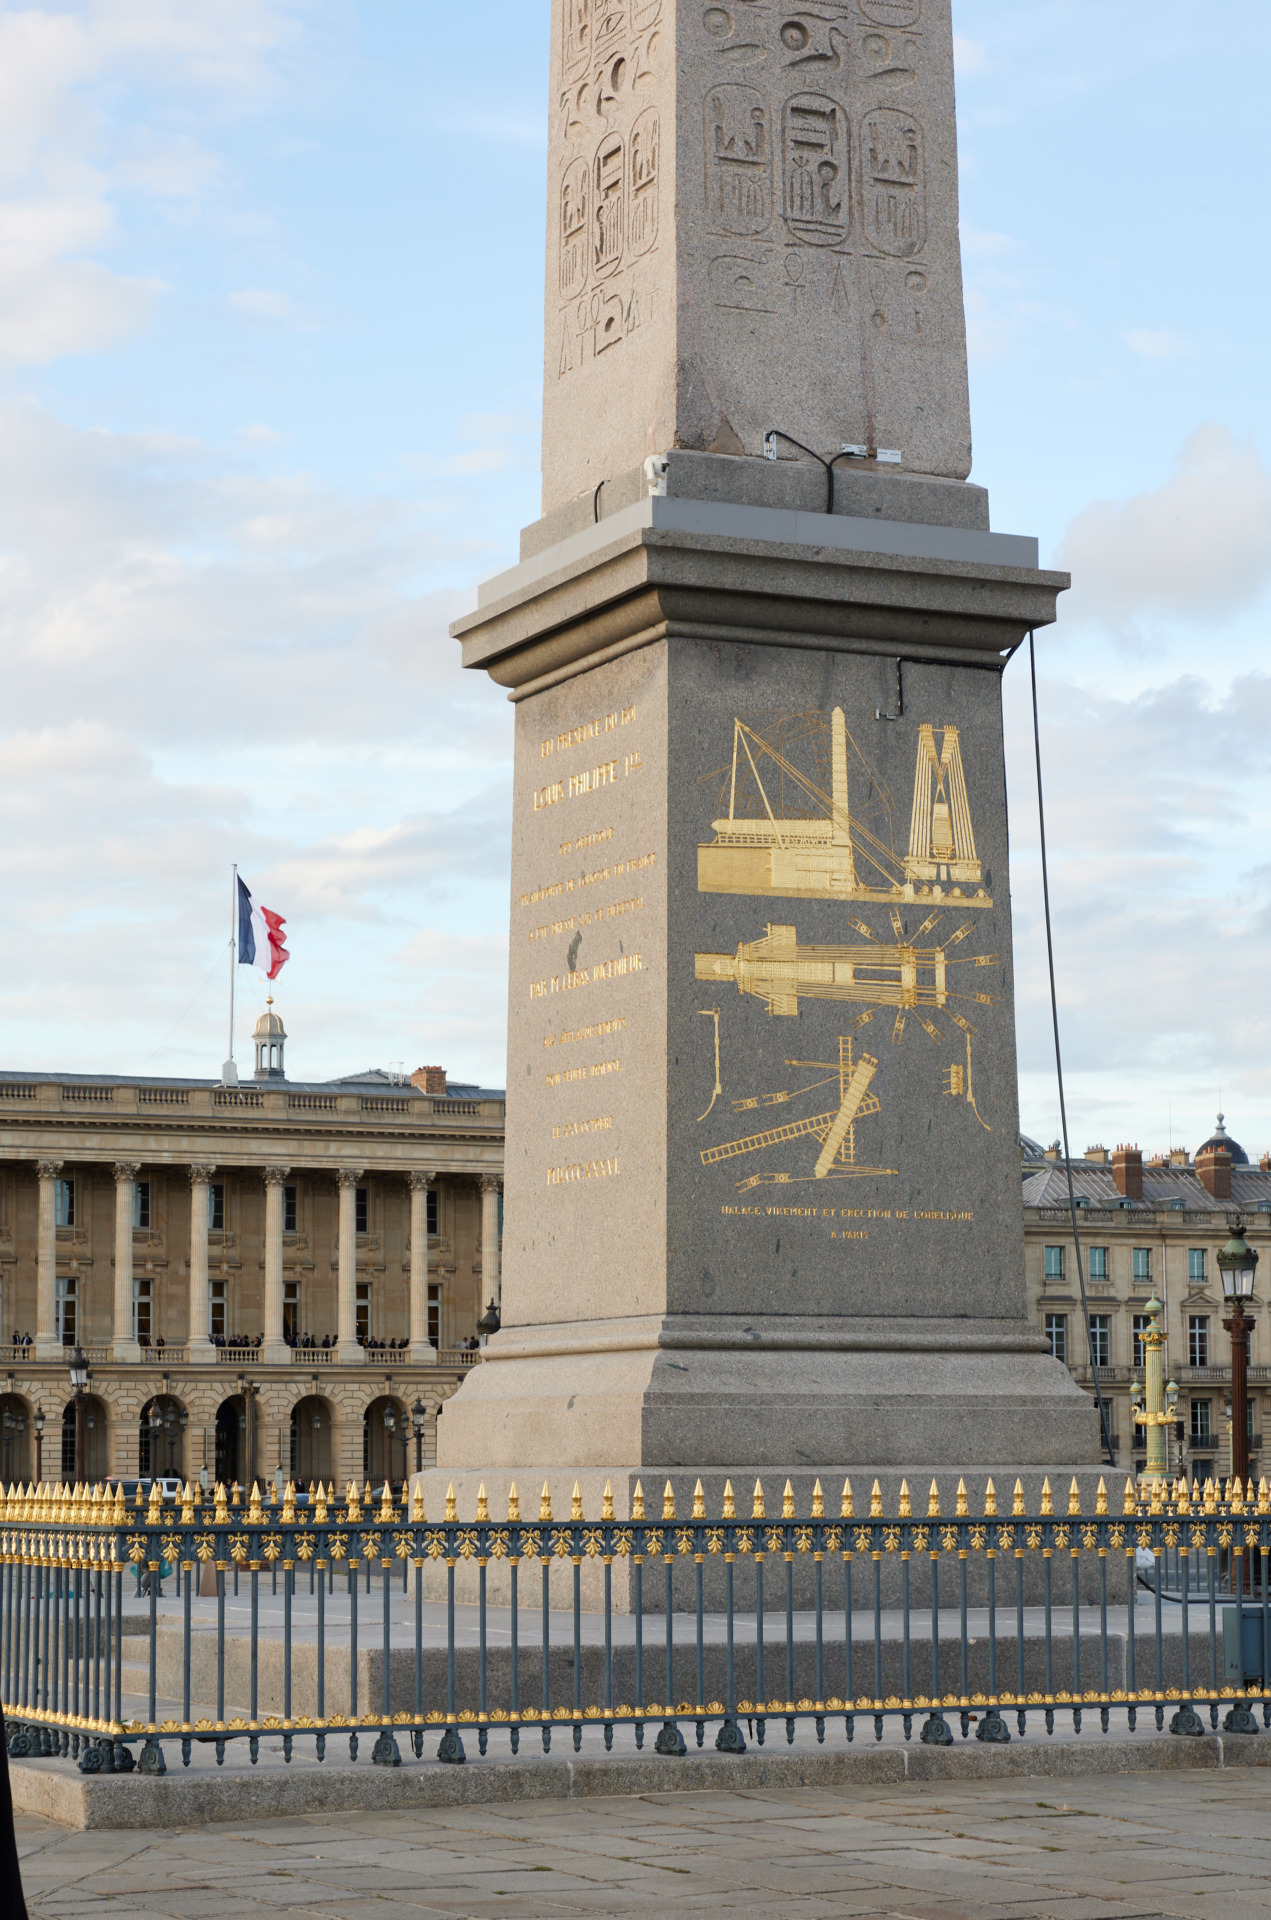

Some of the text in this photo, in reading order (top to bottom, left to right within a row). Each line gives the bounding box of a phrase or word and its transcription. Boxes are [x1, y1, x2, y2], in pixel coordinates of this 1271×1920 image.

[541, 738, 554, 758] EN
[605, 712, 618, 733] DU
[621, 704, 636, 726] ROI
[534, 780, 564, 812] LOUIS
[569, 760, 618, 799] PHILIPPE
[558, 840, 573, 855] CET
[566, 878, 576, 892] DE
[614, 863, 624, 877] EN
[626, 852, 656, 873] FRANCE
[578, 911, 592, 927] SUR
[595, 908, 605, 921] CE
[530, 979, 547, 1000] PAR
[542, 1017, 627, 1048] AUX APPLAUDISSEMENTS
[563, 1066, 587, 1083] PEUPLE
[552, 1125, 561, 1139] LE
[581, 1115, 613, 1133] OCTOBRE
[766, 1206, 818, 1217] VIREMENT
[823, 1208, 836, 1217] ET
[896, 1210, 909, 1219] DE
[830, 1230, 869, 1240] A PARIS
